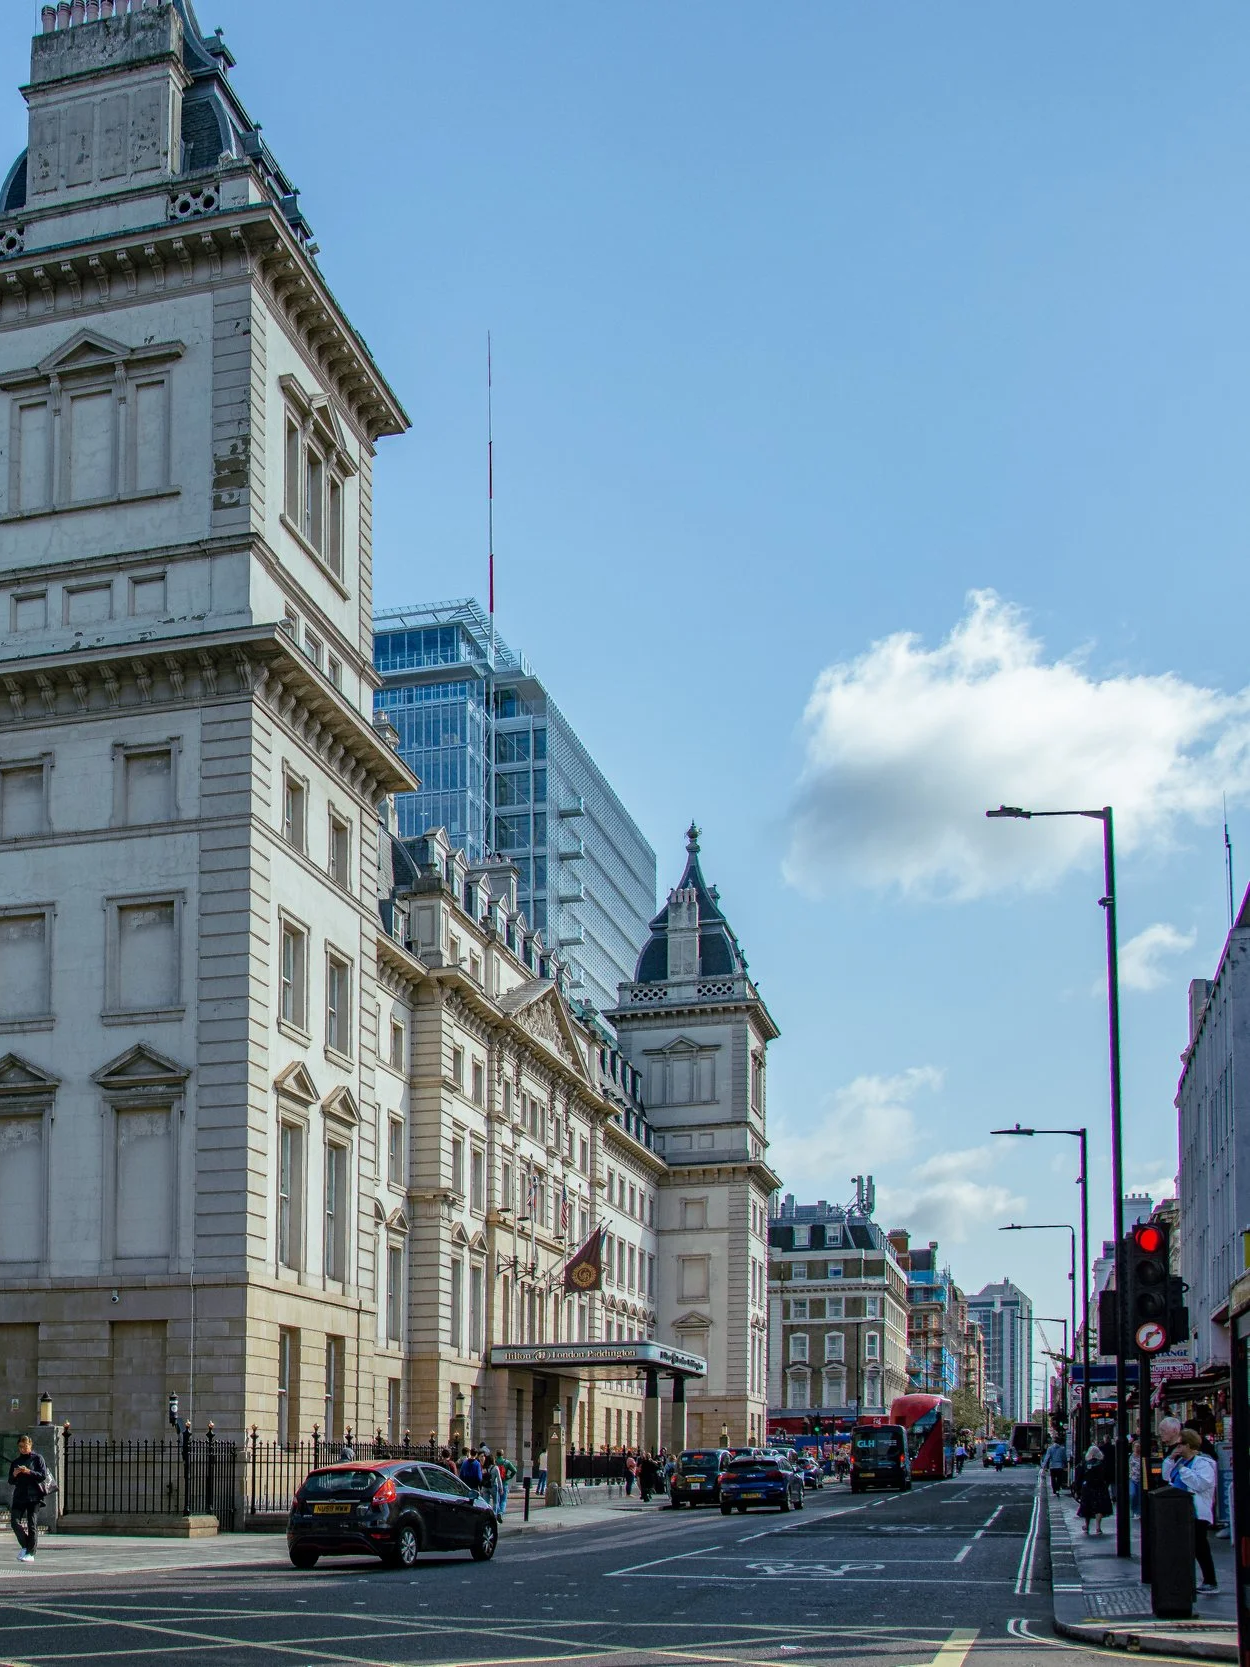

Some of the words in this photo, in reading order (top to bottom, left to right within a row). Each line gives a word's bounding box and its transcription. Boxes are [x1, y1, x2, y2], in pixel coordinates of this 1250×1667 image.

[505, 1352, 531, 1360] Hilton
[552, 1350, 585, 1359] London
[587, 1348, 636, 1359] Paddington
[1150, 1364, 1173, 1372] MOBILE
[857, 1439, 875, 1448] GLH
